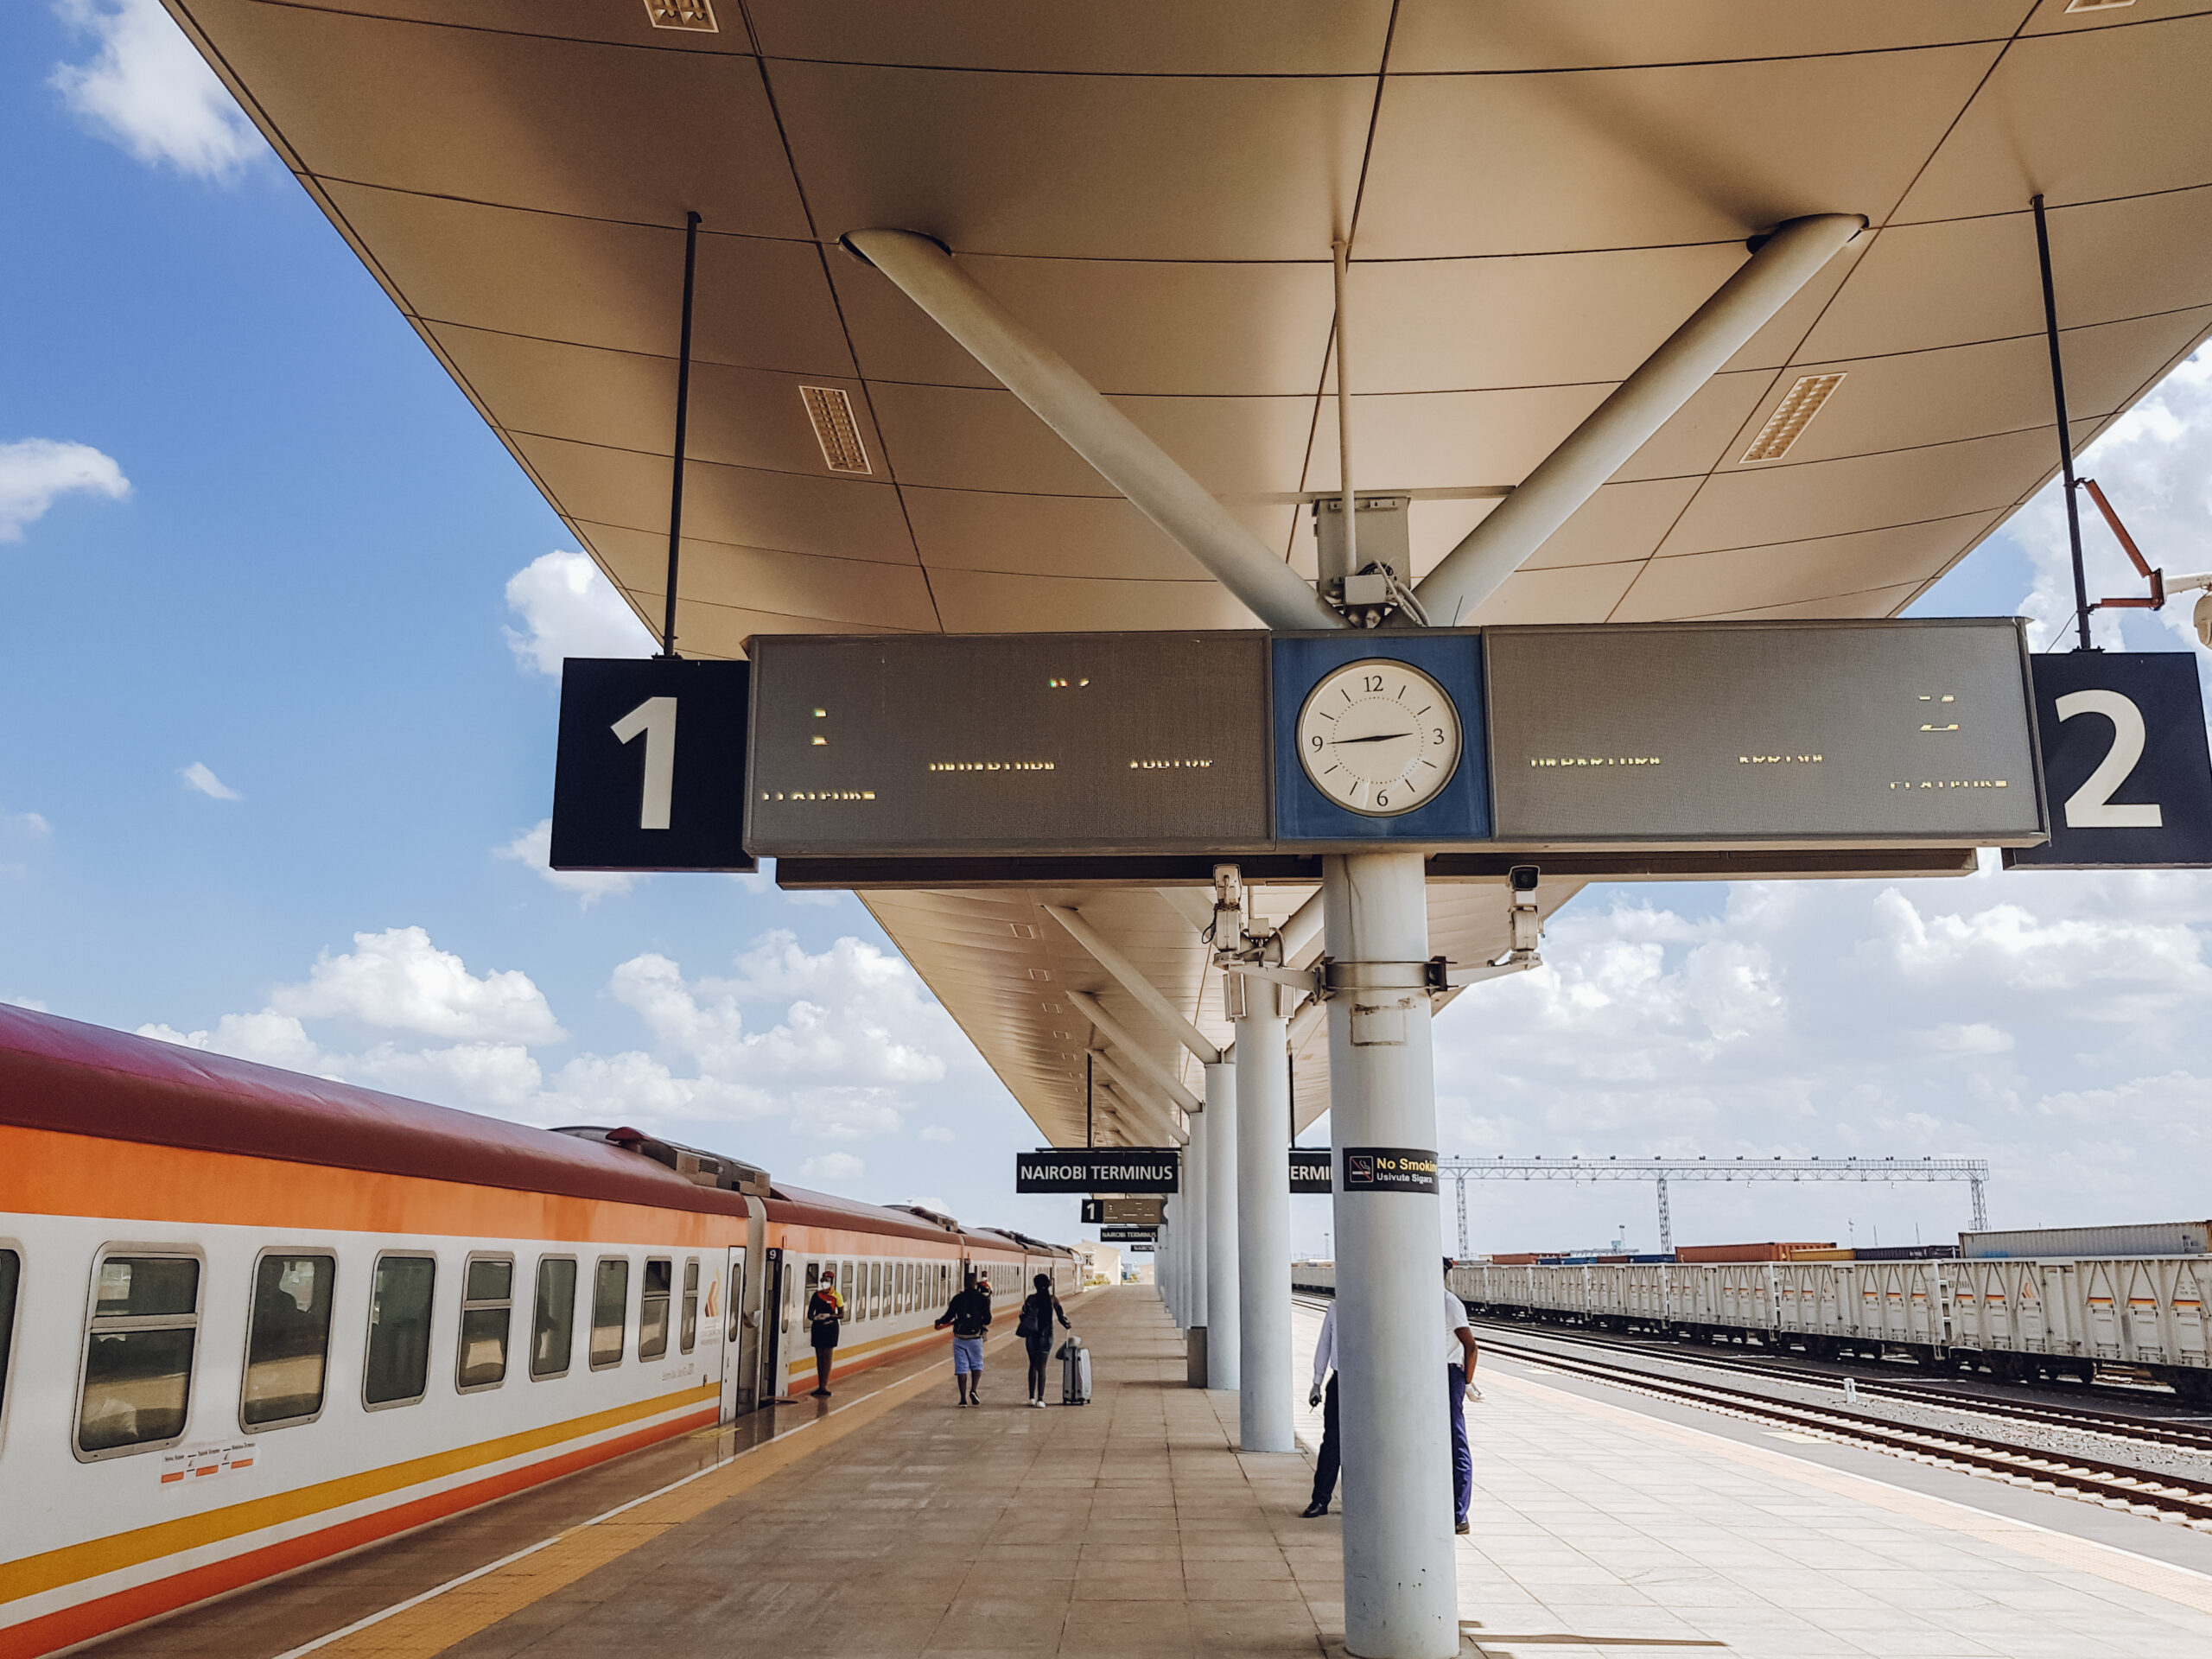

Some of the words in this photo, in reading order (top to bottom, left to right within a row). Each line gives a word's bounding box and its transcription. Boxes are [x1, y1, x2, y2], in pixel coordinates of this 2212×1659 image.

[1363, 676, 1383, 692] 12
[1433, 728, 1445, 744] 3
[1312, 736, 1323, 753] 9
[610, 696, 677, 830] 1
[2055, 689, 2163, 829] 2
[1376, 789, 1388, 806] 6
[1376, 1158, 1396, 1170] No
[1020, 1166, 1086, 1180] NAIROBI
[1090, 1166, 1173, 1180] TERMINUS
[1376, 1173, 1410, 1182] Usivute
[1411, 1173, 1433, 1185] Sigara
[1086, 1203, 1095, 1220] 1
[769, 1249, 777, 1260] 9
